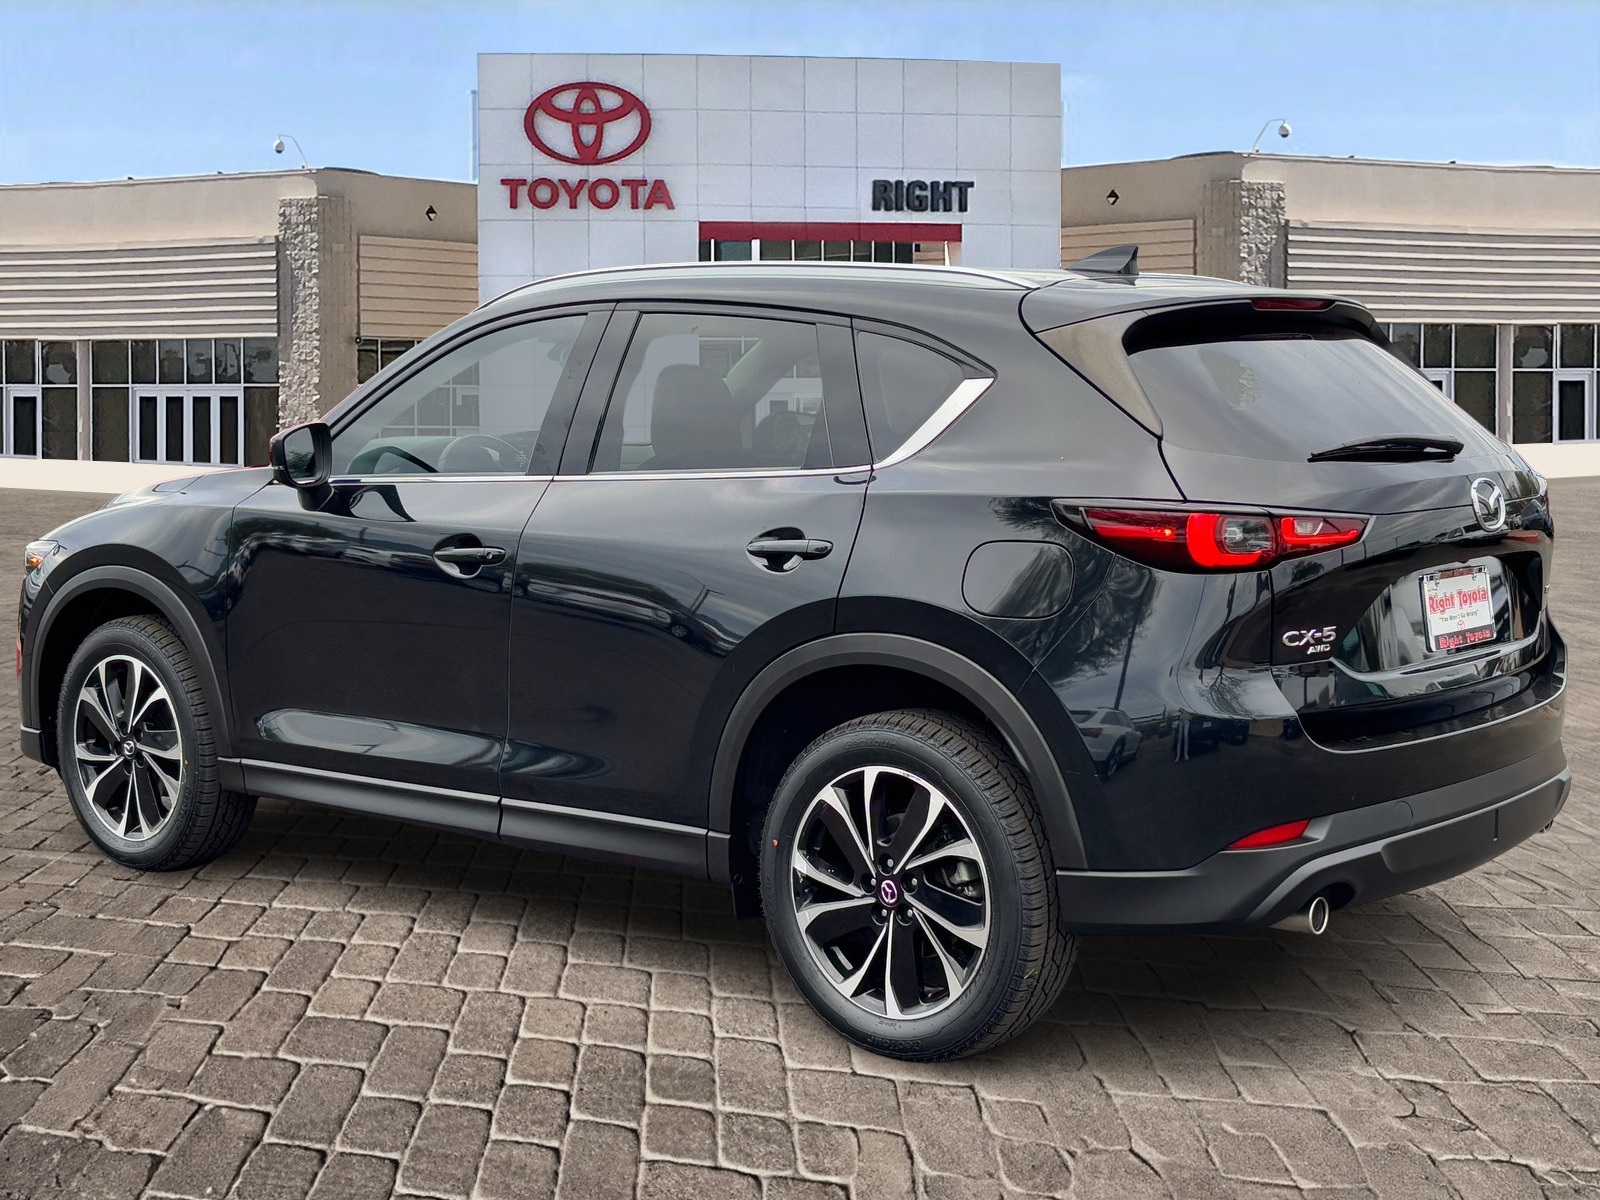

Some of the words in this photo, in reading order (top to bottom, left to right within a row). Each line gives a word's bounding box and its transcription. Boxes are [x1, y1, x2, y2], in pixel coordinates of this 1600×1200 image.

[500, 178, 675, 209] TOYOTA
[872, 180, 975, 212] RIGHT
[1428, 592, 1455, 615] Right
[1457, 586, 1488, 609] Toyota
[1282, 626, 1337, 647] CX-5
[1439, 635, 1463, 650] Right
[1466, 629, 1491, 643] Toyota
[1306, 644, 1331, 655] AWD
